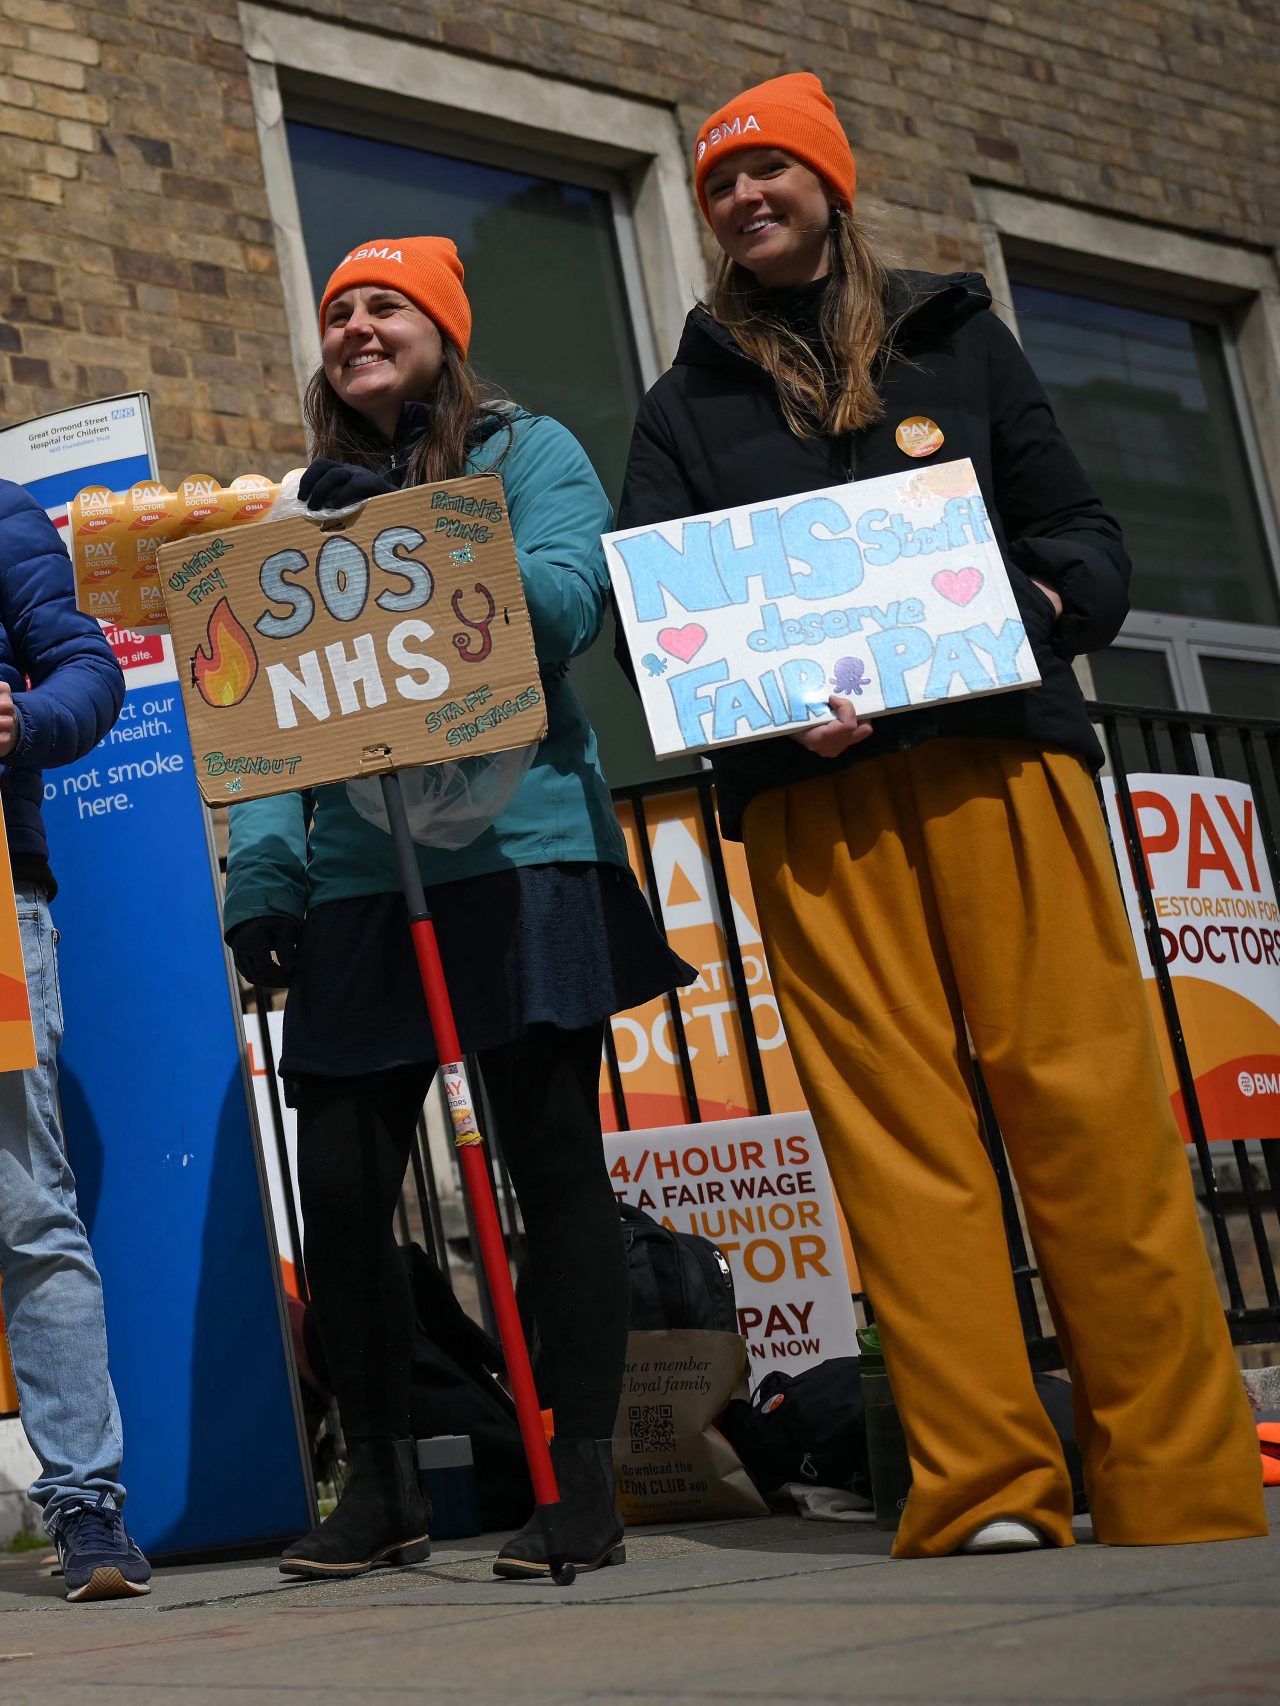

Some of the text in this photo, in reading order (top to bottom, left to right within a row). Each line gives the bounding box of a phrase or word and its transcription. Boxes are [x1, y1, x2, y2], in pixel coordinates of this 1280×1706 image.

[709, 114, 761, 147] BMA
[354, 247, 403, 264] BMA
[112, 407, 135, 420] NHS
[28, 416, 109, 442] Great Ormond Street
[30, 425, 110, 451] Hospital for Children
[900, 420, 931, 438] PAY
[80, 490, 111, 508] PAY
[131, 486, 162, 502] PAY
[183, 480, 215, 497] PAY
[237, 492, 270, 501] DOCTORS
[81, 507, 113, 517] DOCTORS
[133, 502, 166, 512] DOCTORS
[185, 497, 218, 507] DOCTORS
[431, 490, 503, 523] PATIENTS
[434, 516, 494, 544] DYING
[84, 541, 116, 558] PAY
[612, 495, 993, 623] NHS Staff
[85, 558, 118, 568] DOCTORS
[167, 538, 234, 593] UNFAIR
[140, 586, 160, 600] PA
[186, 567, 228, 605] PAY
[253, 525, 435, 640] SOS
[88, 590, 120, 606] PAY
[141, 602, 165, 610] DOCTO
[90, 606, 122, 615] DOCTORS
[746, 596, 927, 653] deserve
[131, 650, 153, 662] site.
[264, 618, 451, 729] NHS
[666, 617, 1027, 750] FAIR PAY
[142, 697, 175, 716] our
[425, 684, 493, 734] STAFF
[445, 685, 541, 748] SHORTAGES
[109, 717, 172, 746] health.
[62, 769, 102, 796] not
[108, 752, 185, 785] smoke
[203, 750, 302, 777] BURNOUT
[77, 792, 134, 820] here.
[1114, 791, 1261, 893] PAY
[1139, 896, 1280, 922] ESTORATION FOR
[444, 1080, 462, 1097] AY
[609, 1135, 811, 1184] 4/HOUR IS
[637, 1188, 657, 1210] A
[662, 1181, 727, 1209] FAIR
[730, 1170, 816, 1201] WAGE
[689, 1200, 823, 1239] JUNIOR
[737, 1301, 815, 1340] PAY
[771, 1337, 821, 1359] NOW
[654, 1355, 712, 1373] member
[629, 1376, 662, 1397] loyal
[662, 1375, 712, 1395] family
[621, 1460, 693, 1477] Download the
[650, 1478, 687, 1495] CLUB
[688, 1481, 708, 1493] app
